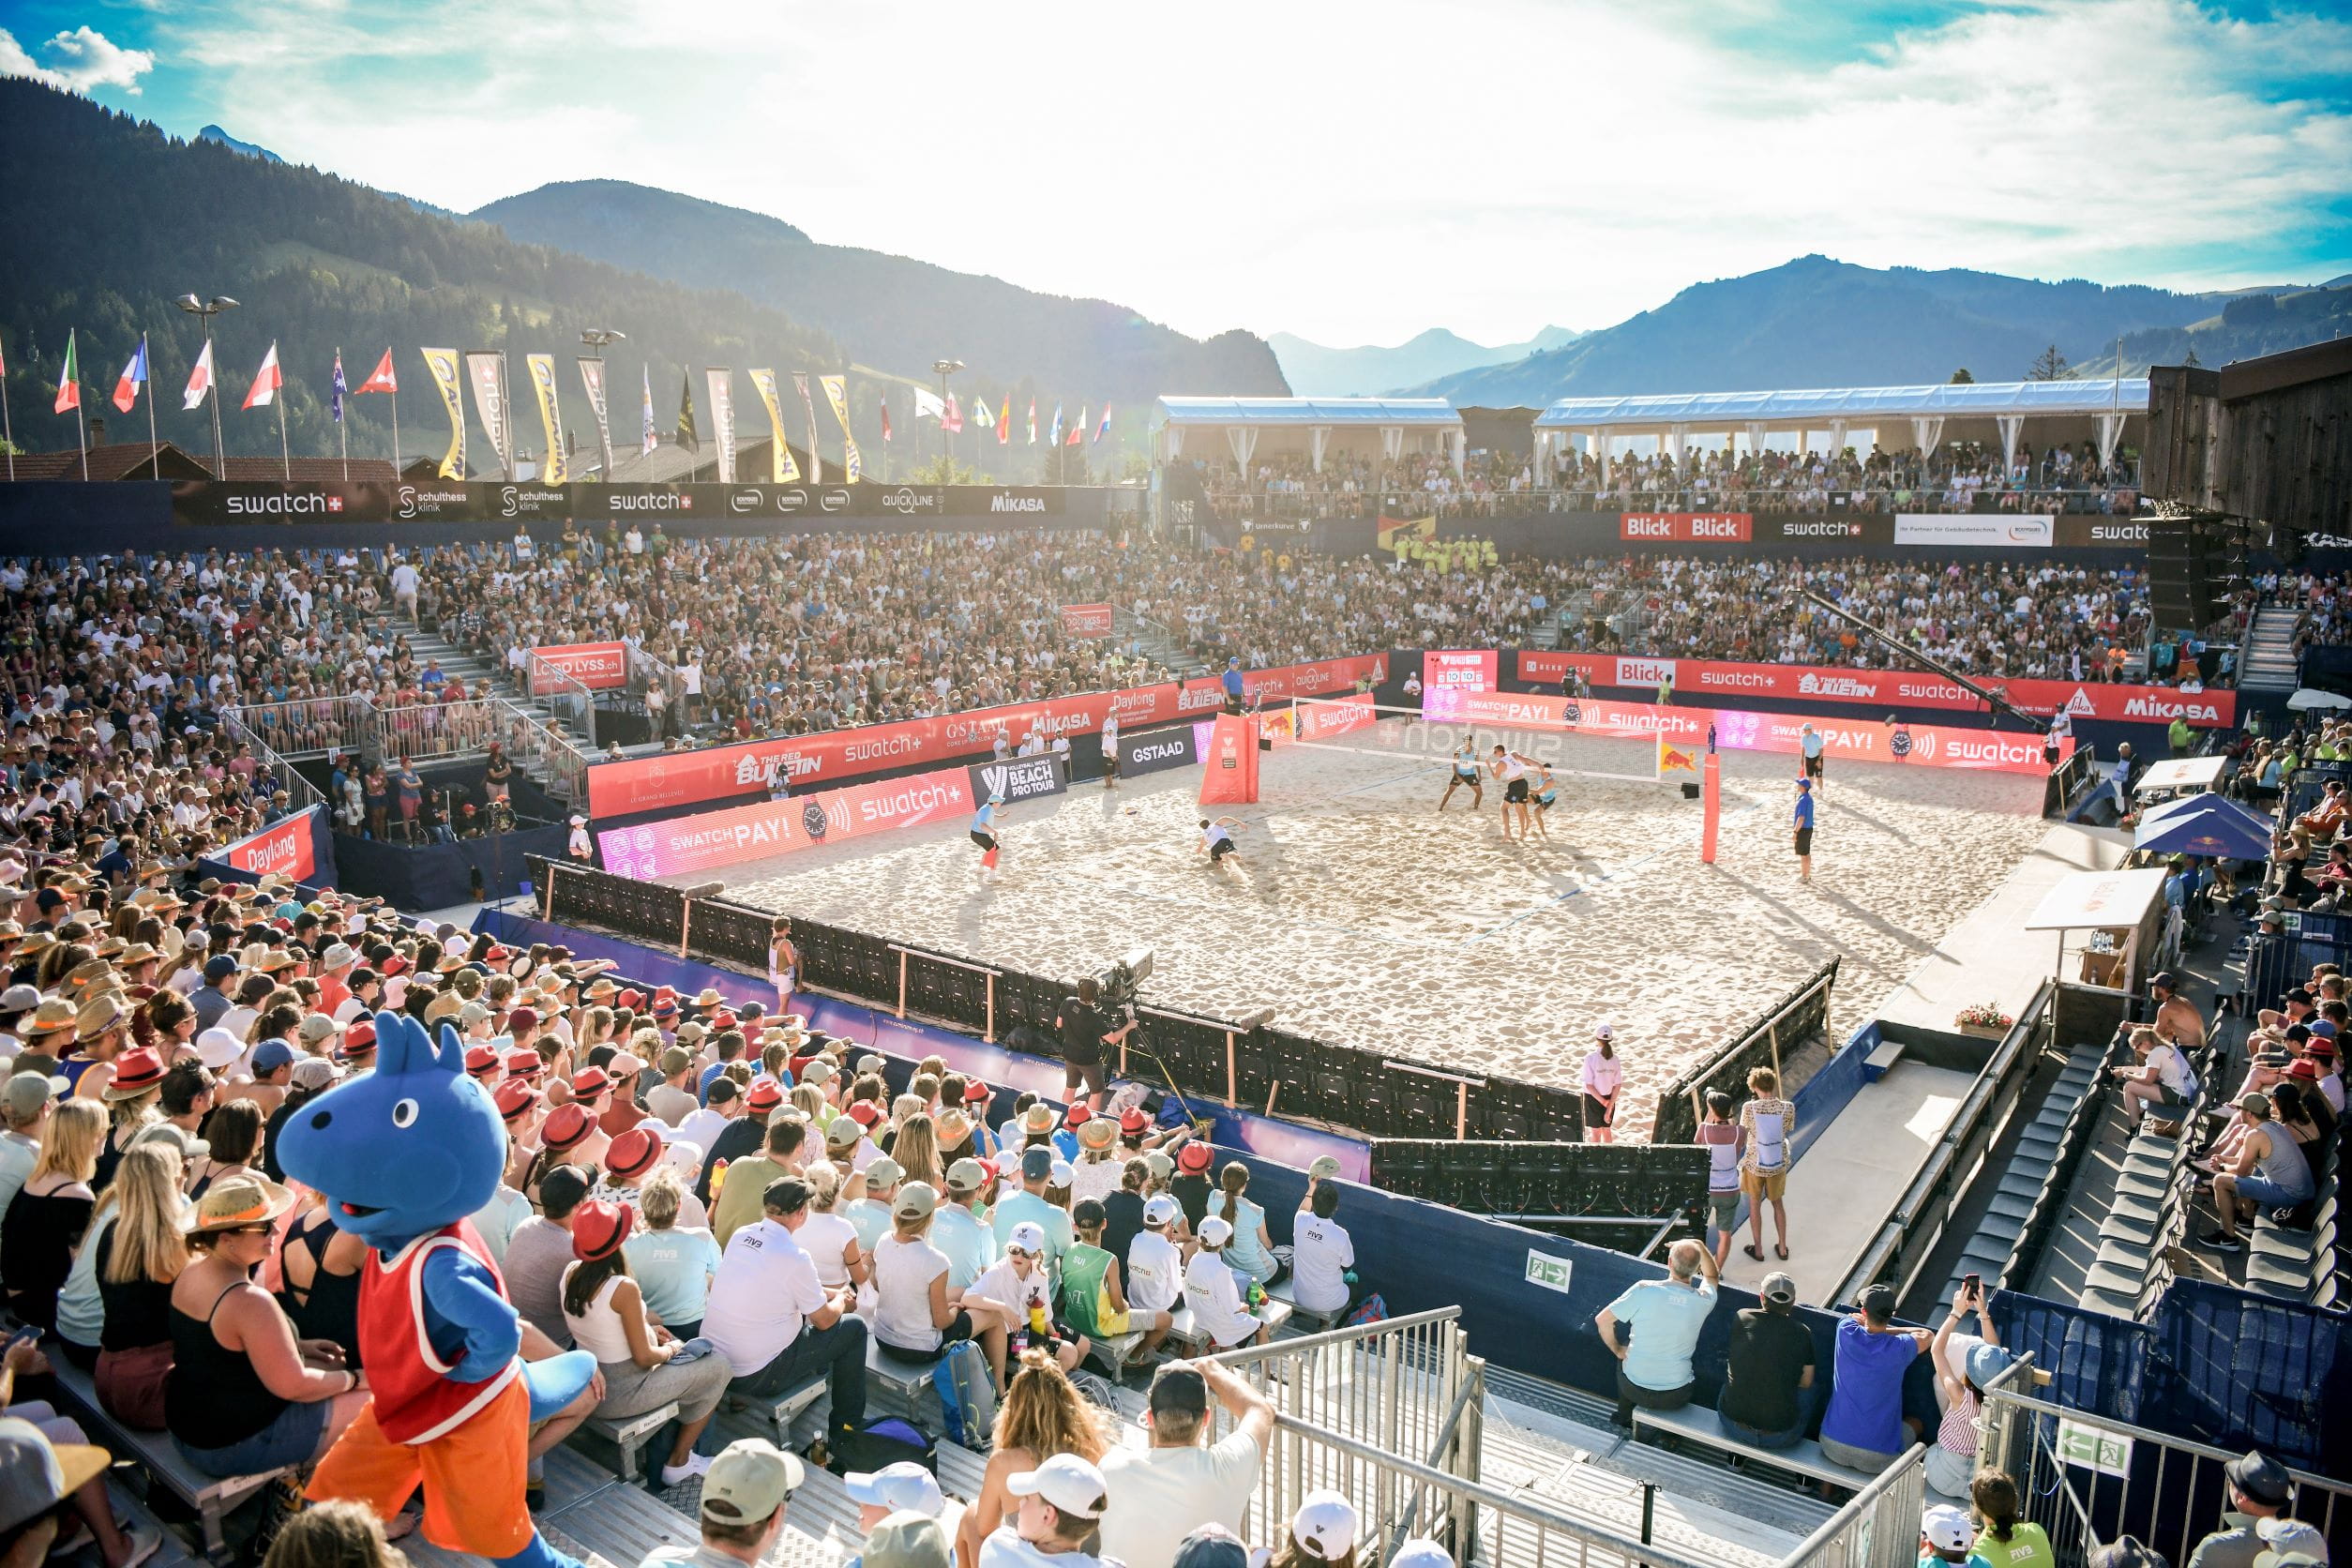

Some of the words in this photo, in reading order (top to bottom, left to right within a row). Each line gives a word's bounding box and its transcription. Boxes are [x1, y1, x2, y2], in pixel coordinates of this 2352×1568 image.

[227, 493, 326, 515] swatch
[417, 491, 467, 502] schulthess
[519, 491, 564, 501] schulthess
[610, 492, 680, 510] swatch
[418, 502, 441, 512] klinik
[519, 501, 540, 511] klinik
[1627, 518, 1671, 536] Blick
[1692, 518, 1738, 537] Blick
[1783, 521, 1848, 536] swatch
[2091, 525, 2149, 540] swatc
[1621, 664, 1664, 682] Blick
[1700, 671, 1764, 687] swatch
[1819, 676, 1836, 685] THE
[1836, 677, 1858, 686] RED
[1243, 678, 1277, 696] watch
[1798, 680, 1877, 698] BULLETIN
[1899, 684, 1968, 701] swatch
[1112, 690, 1155, 711] Daylong
[2066, 696, 2090, 713] Sika
[1467, 699, 1508, 713] SWATCH
[1508, 702, 1549, 721] PAY!
[845, 734, 912, 762] swatch
[1822, 730, 1873, 749] PAY!
[761, 756, 781, 765] THE
[782, 751, 802, 761] RED
[1132, 741, 1184, 762] GSTAAD
[1947, 739, 2041, 765] swatch
[1009, 763, 1053, 787] BEACH
[1012, 784, 1032, 797] PRO
[1032, 778, 1055, 794] TOUR
[860, 784, 946, 822] swatch
[670, 827, 732, 852] SWATCH
[734, 817, 791, 848] PAY!
[247, 832, 296, 872] Daylong
